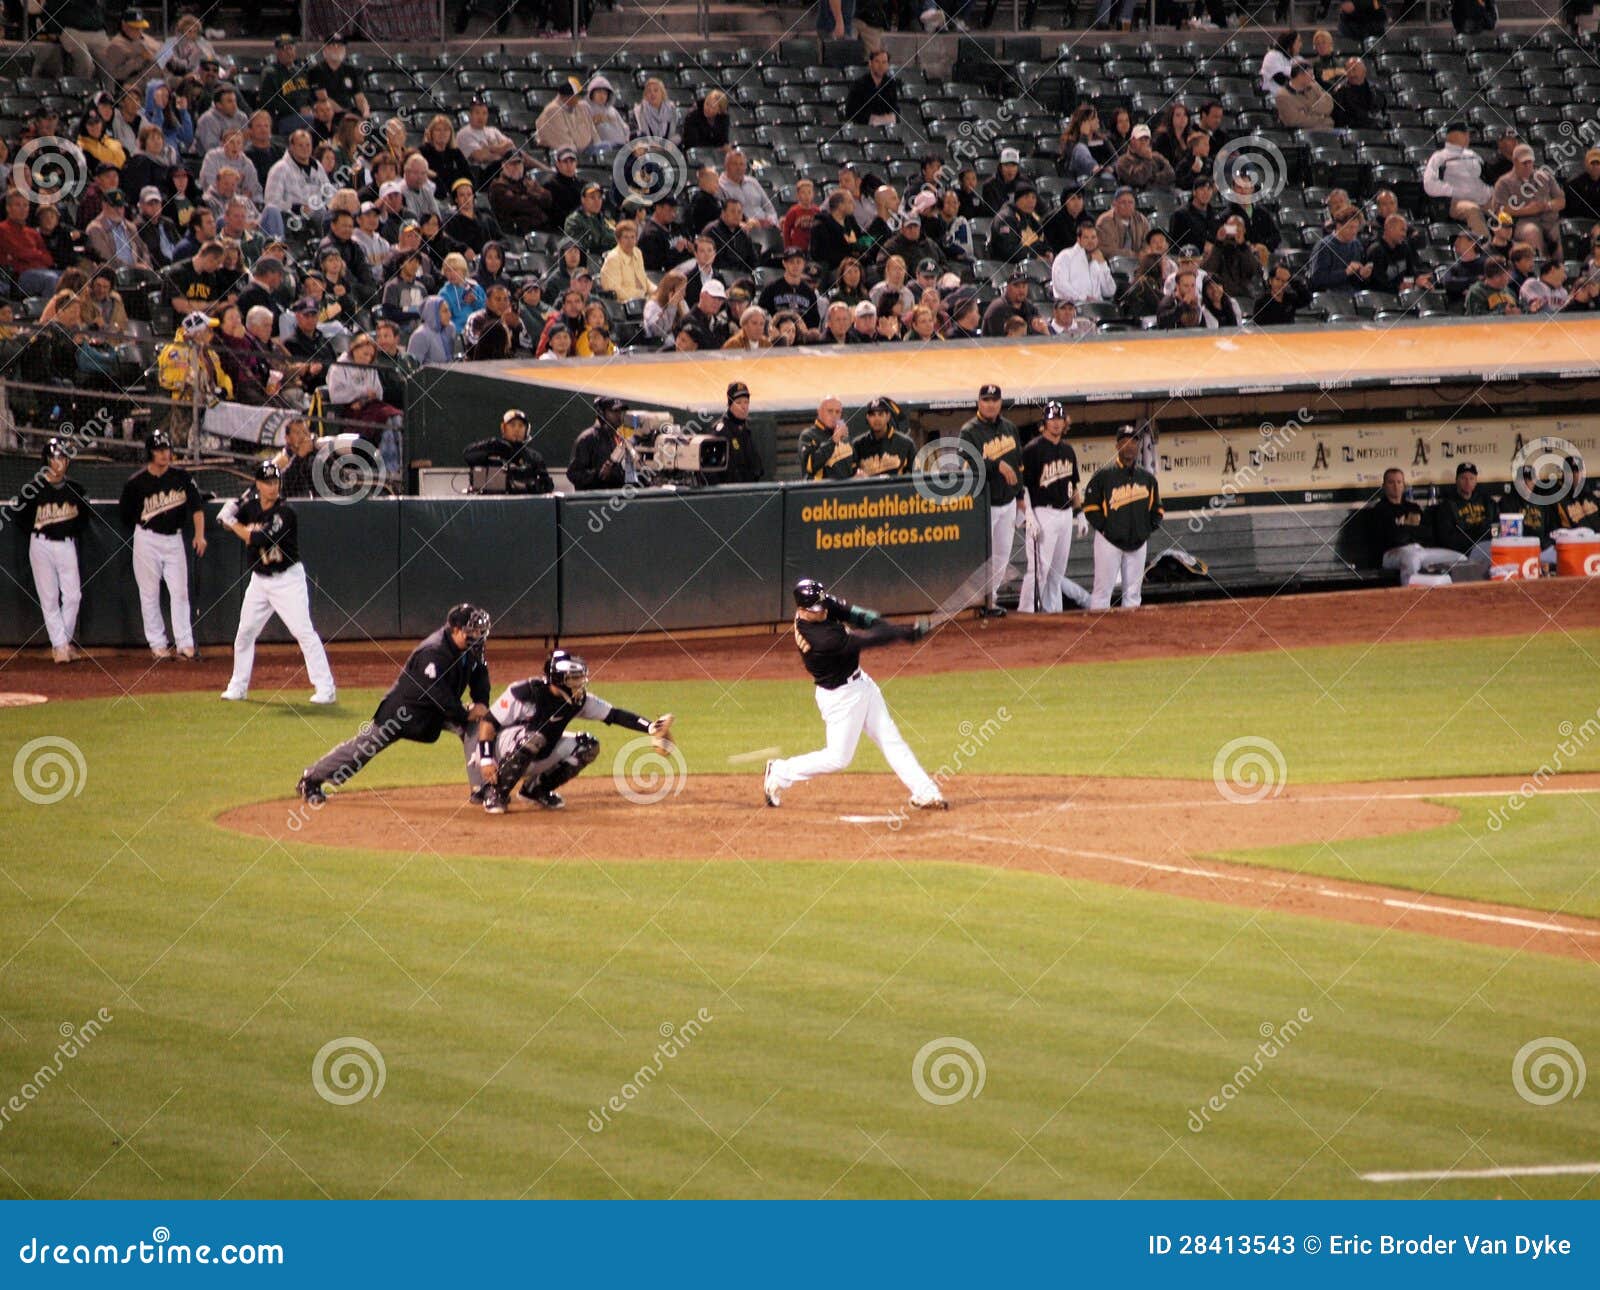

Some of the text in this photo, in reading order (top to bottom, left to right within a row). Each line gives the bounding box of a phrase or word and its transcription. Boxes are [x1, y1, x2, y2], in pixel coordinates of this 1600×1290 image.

[1356, 447, 1399, 459] NETSUITE
[1456, 443, 1497, 455] NETSUITE
[1174, 455, 1211, 468] NETSUITE
[1263, 450, 1306, 463] NETSUITE
[801, 494, 974, 523] oaklandathletics.com
[816, 523, 960, 550] losatleticos.com
